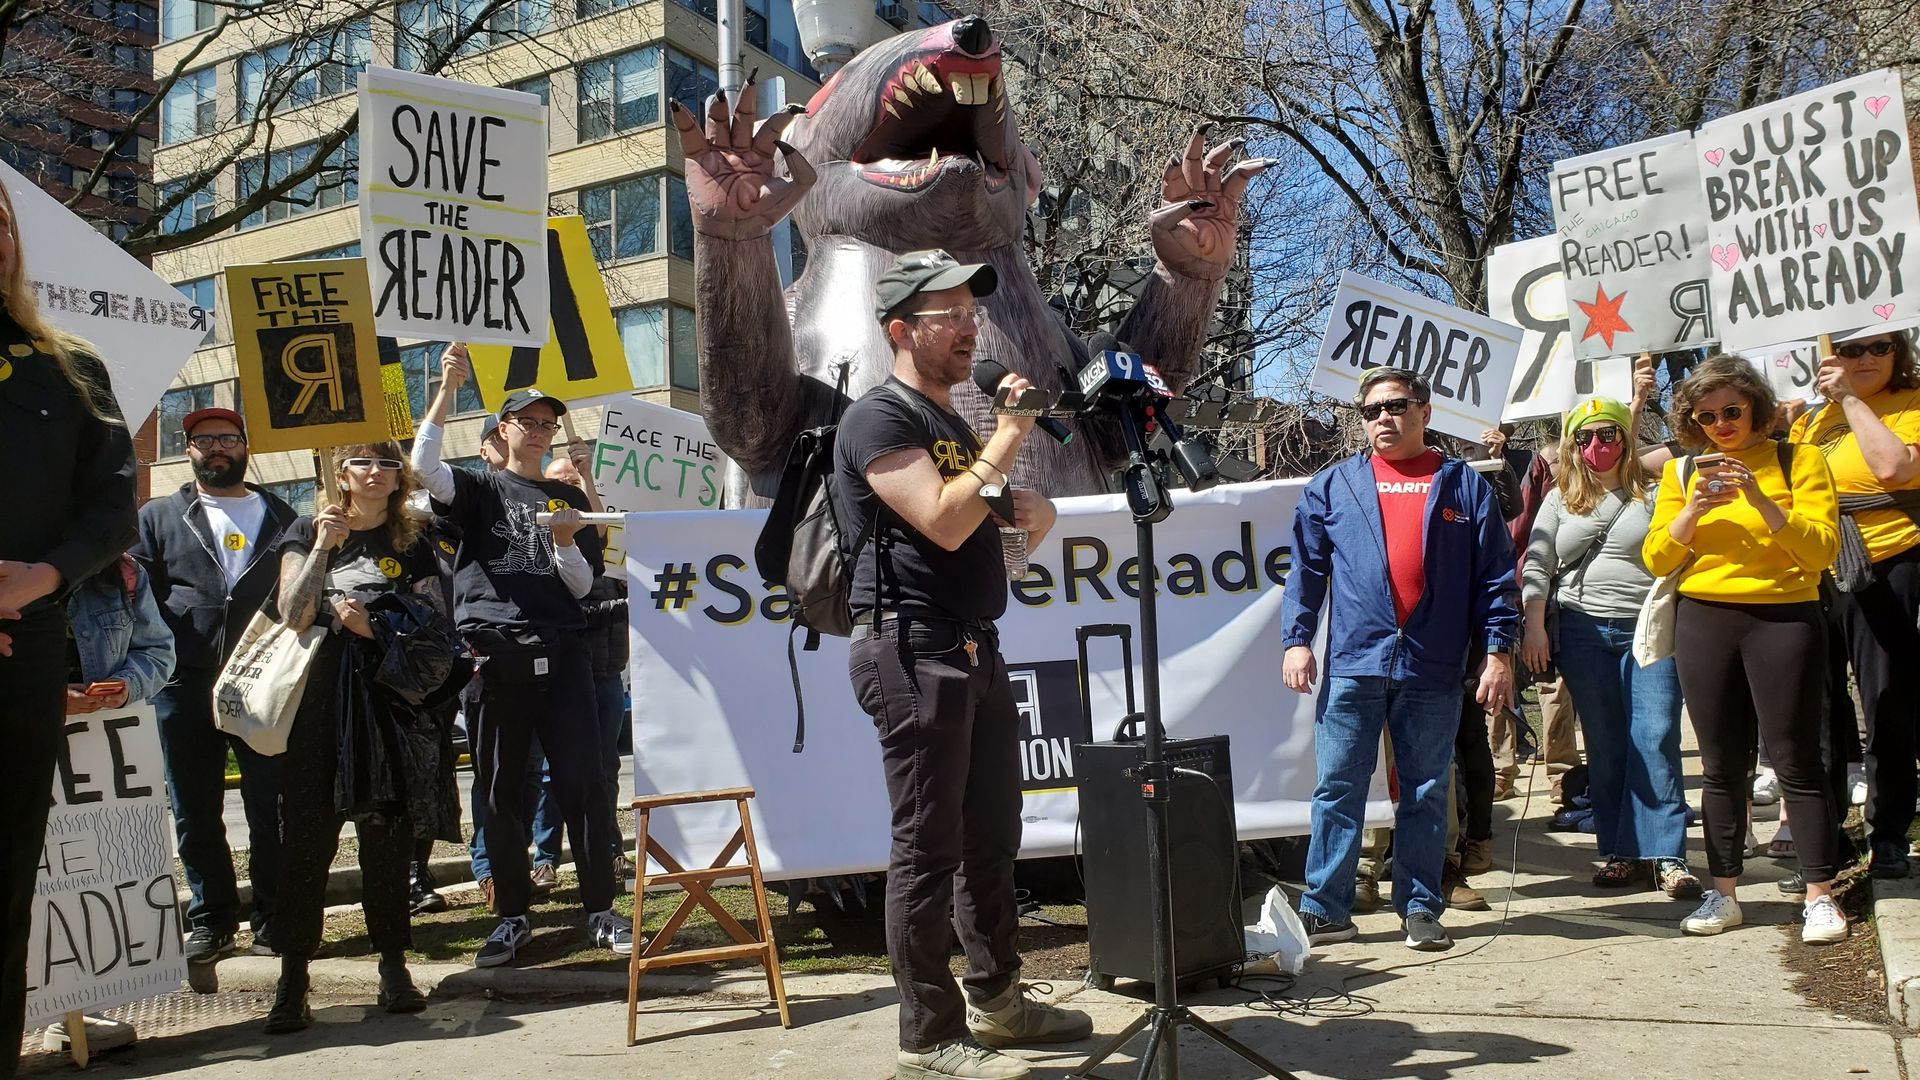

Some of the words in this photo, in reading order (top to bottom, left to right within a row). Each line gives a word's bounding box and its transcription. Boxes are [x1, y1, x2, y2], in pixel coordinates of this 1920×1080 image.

[388, 104, 506, 202] SAVE
[1729, 90, 1857, 166] JUST
[1557, 151, 1666, 212] FREE
[1706, 145, 1827, 222] BREAK
[1843, 129, 1901, 189] UP
[424, 201, 469, 230] THE
[1558, 212, 1585, 238] THE
[1585, 208, 1639, 239] CHICAGO
[1735, 205, 1813, 262] WITH
[1828, 186, 1886, 241] US
[1561, 223, 1693, 281] READER!
[1728, 232, 1906, 325] ALREADY
[251, 272, 349, 310] FREE
[257, 309, 341, 328] THE
[1080, 356, 1106, 388] WGN
[1115, 352, 1133, 380] 9
[605, 411, 662, 448] FACE
[673, 435, 716, 461] THE
[595, 443, 717, 507] FACTS
